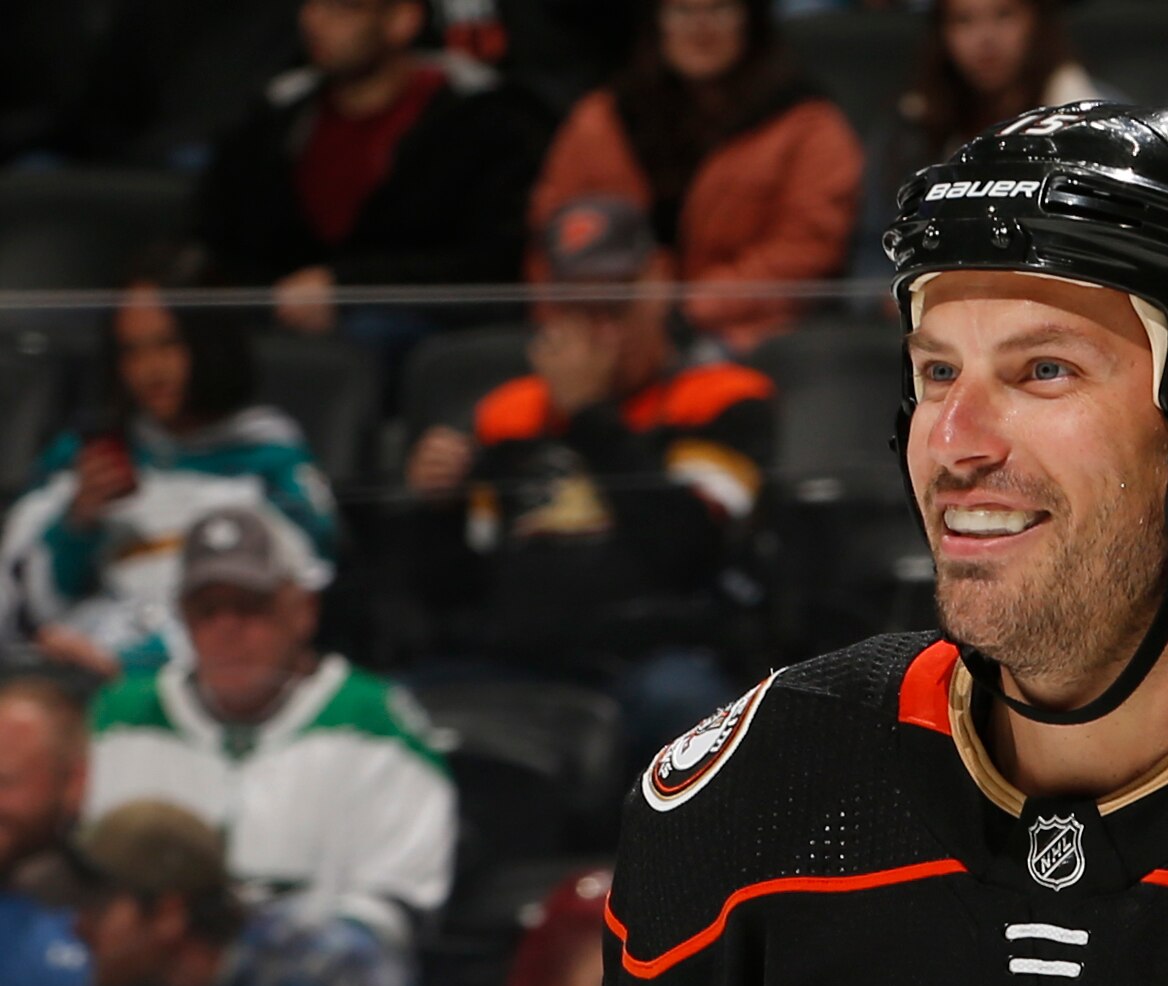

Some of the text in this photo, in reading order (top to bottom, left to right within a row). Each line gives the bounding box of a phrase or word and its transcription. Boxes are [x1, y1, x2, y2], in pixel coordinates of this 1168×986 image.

[995, 113, 1085, 136] 15
[925, 180, 1041, 201] BAUER
[1041, 837, 1072, 873] NHL
